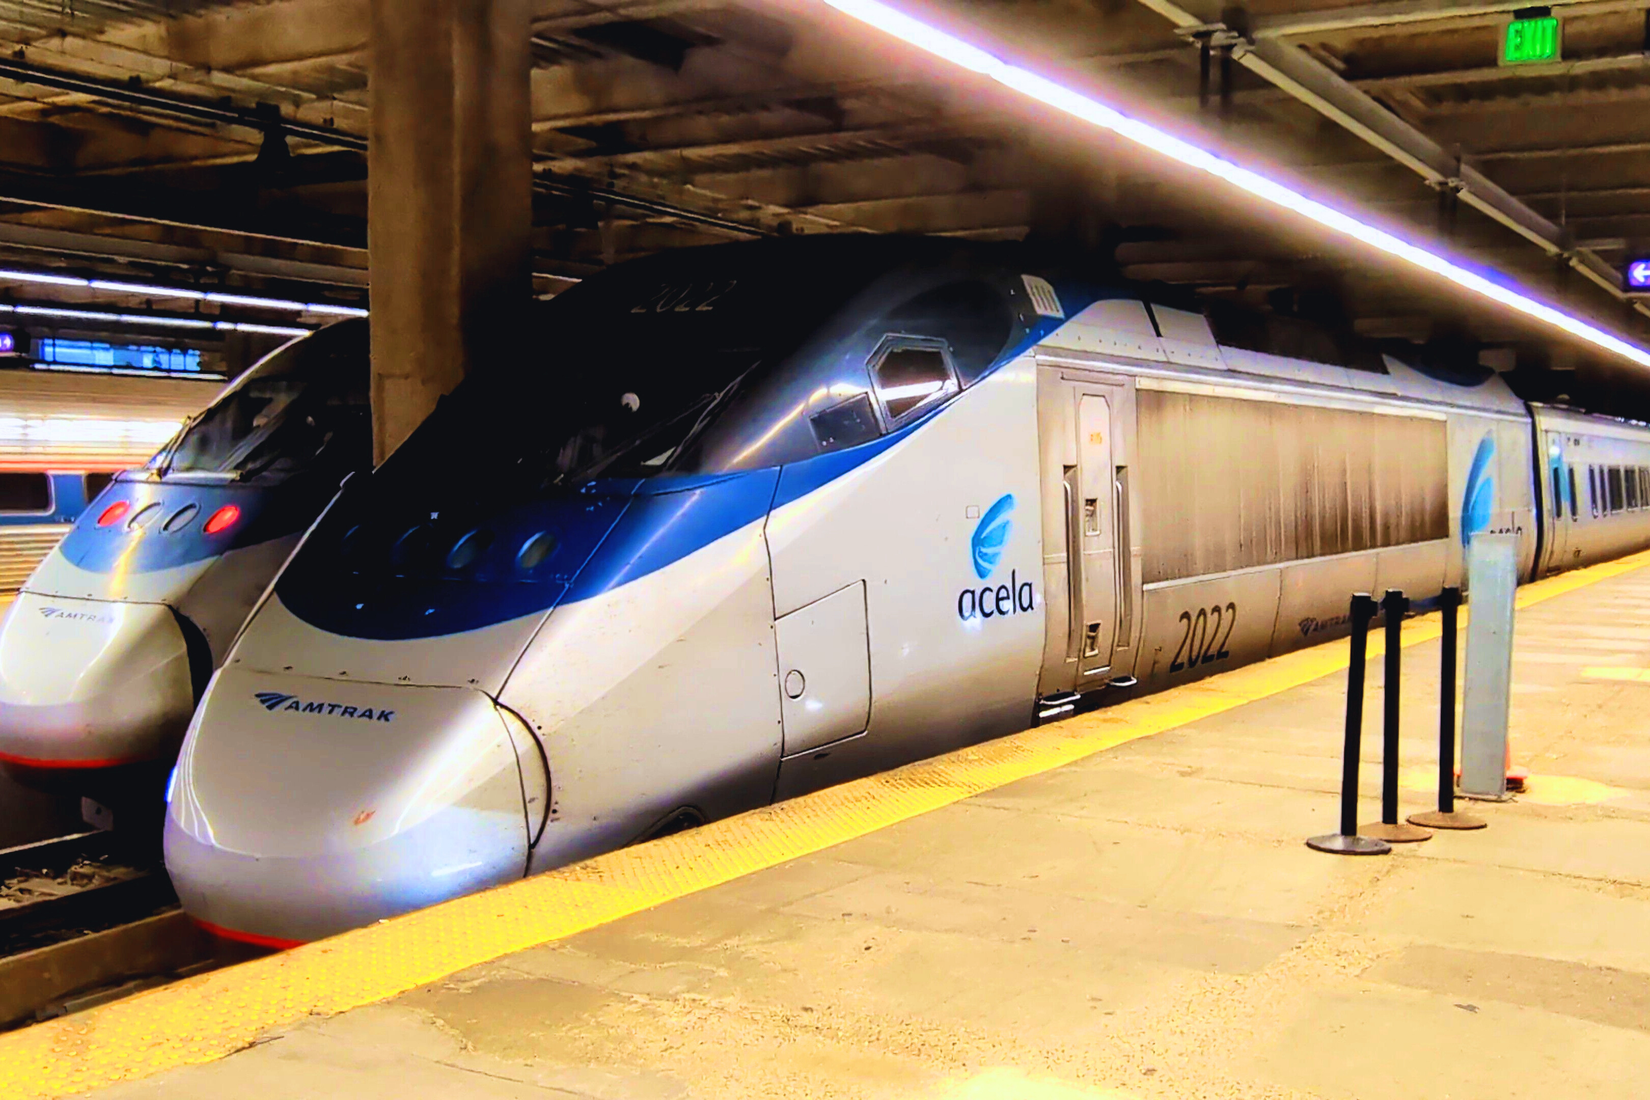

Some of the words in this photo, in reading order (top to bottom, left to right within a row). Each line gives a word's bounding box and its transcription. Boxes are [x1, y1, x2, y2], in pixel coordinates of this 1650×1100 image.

[1506, 18, 1558, 61] EXIT
[630, 280, 737, 313] 2022
[958, 568, 1034, 621] acela
[1169, 602, 1236, 674] 2022
[284, 700, 395, 722] AMTRAK
